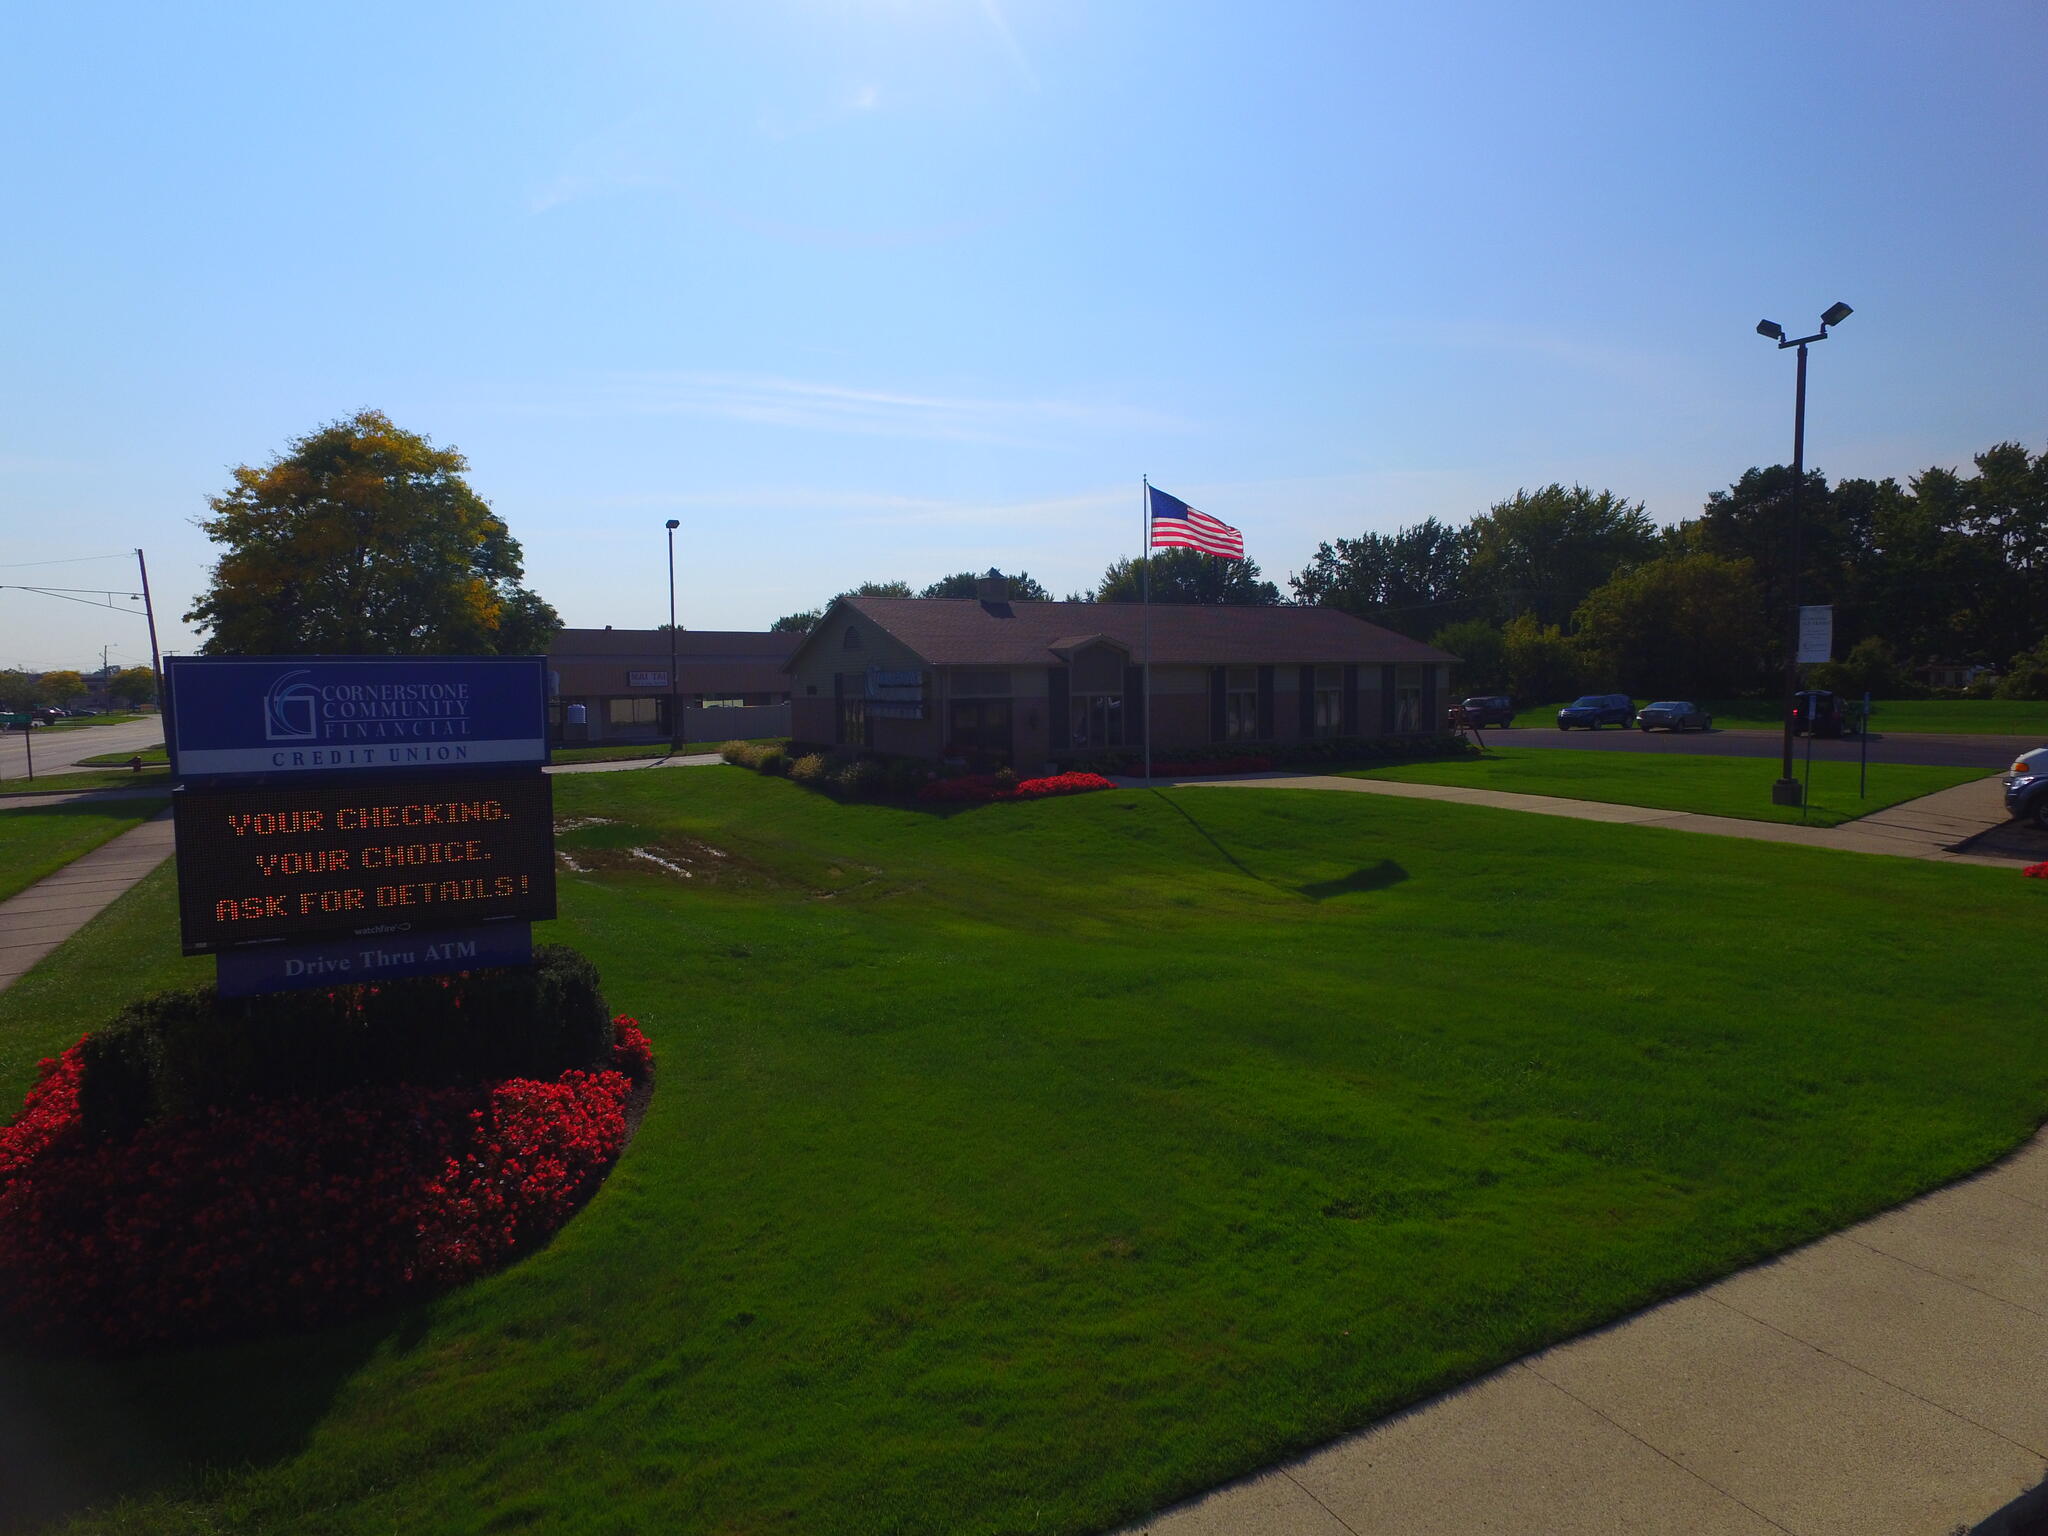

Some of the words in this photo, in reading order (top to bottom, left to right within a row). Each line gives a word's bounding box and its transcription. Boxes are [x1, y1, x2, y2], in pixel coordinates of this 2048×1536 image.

[322, 683, 469, 701] CORNERSTONE
[323, 701, 469, 718] COMMUNITY
[325, 722, 471, 739] FINANCIAL
[272, 748, 375, 767] CREDIT
[389, 745, 468, 763] UNION
[228, 810, 325, 836] YOUR
[255, 849, 350, 877] YOUR
[361, 840, 492, 869] CHOICE.
[215, 895, 288, 922] ASK
[300, 887, 365, 915] FOR
[376, 875, 530, 908] DETAILS!
[285, 956, 351, 976] Drive
[359, 950, 416, 968] Thru
[424, 941, 477, 961] ATM
